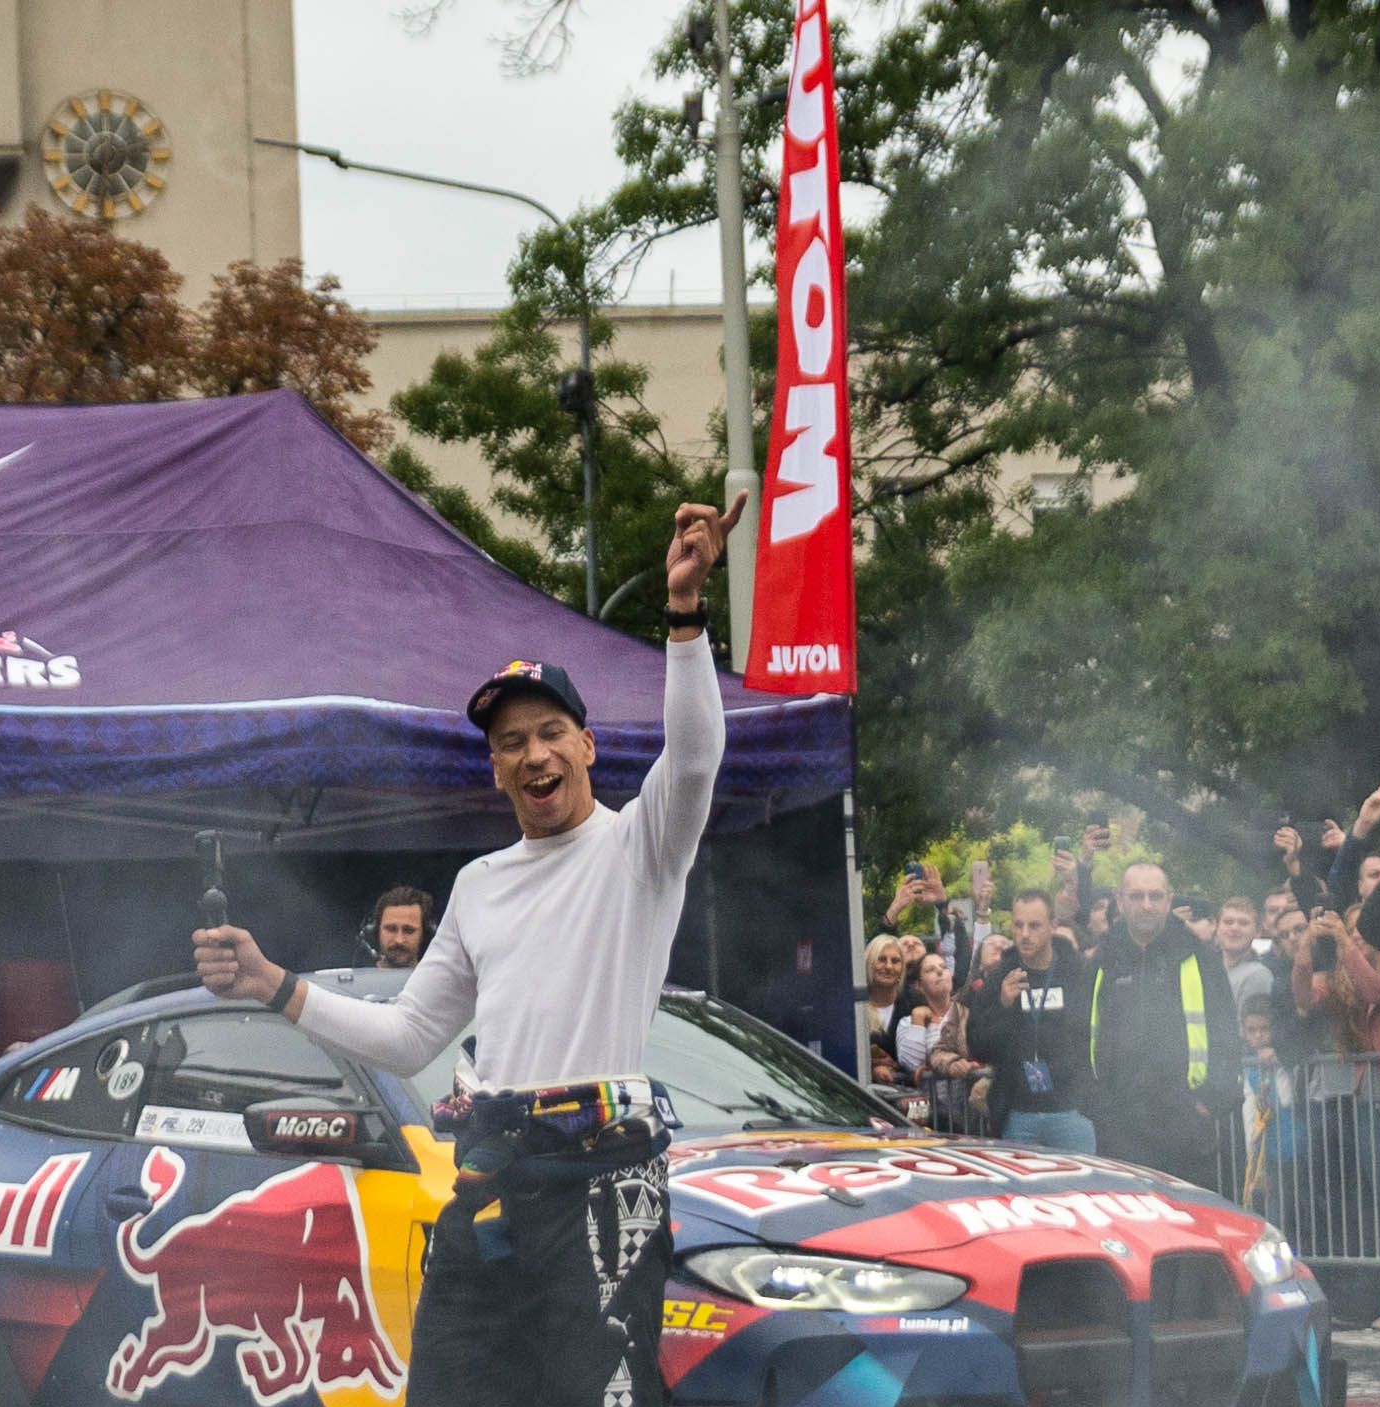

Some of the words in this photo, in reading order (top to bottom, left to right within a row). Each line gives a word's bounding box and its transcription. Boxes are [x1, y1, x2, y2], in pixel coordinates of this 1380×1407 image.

[275, 1116, 346, 1137] MoTeC
[667, 1147, 1010, 1218] Red
[947, 1193, 1196, 1237] MOTUL
[898, 1316, 969, 1333] tuning.pl
